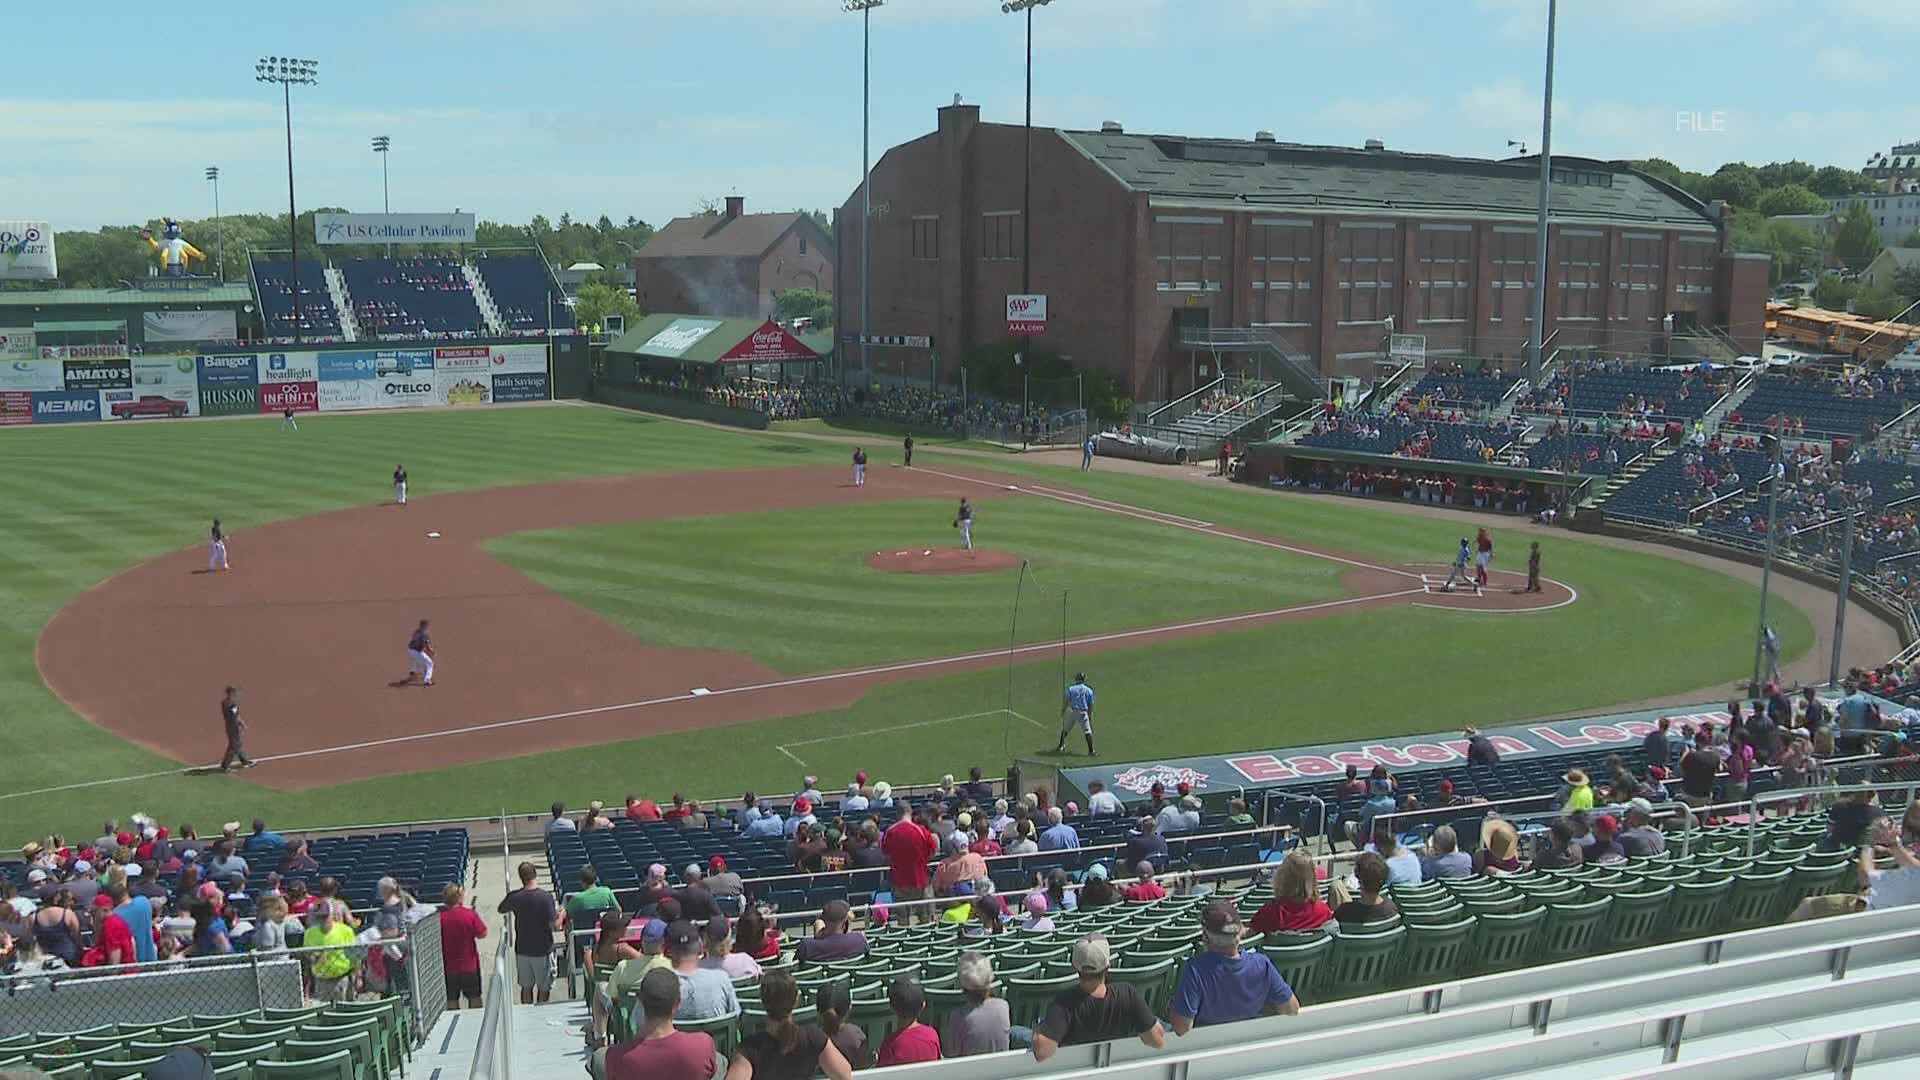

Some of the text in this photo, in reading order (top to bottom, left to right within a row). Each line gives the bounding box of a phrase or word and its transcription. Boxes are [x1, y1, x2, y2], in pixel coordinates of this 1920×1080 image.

[368, 225, 417, 238] Cellular
[420, 224, 466, 237] Pavilion
[1009, 323, 1045, 331] AAA.com
[204, 355, 251, 368] Bangor
[66, 368, 131, 380] AMATO'S
[266, 367, 312, 381] headlight
[494, 379, 515, 387] Bath
[515, 379, 546, 388] Savings
[203, 388, 256, 404] HUSSON
[263, 392, 318, 405] INFINITY
[37, 400, 97, 414] MEMIC
[1225, 735, 1538, 783] Eastern
